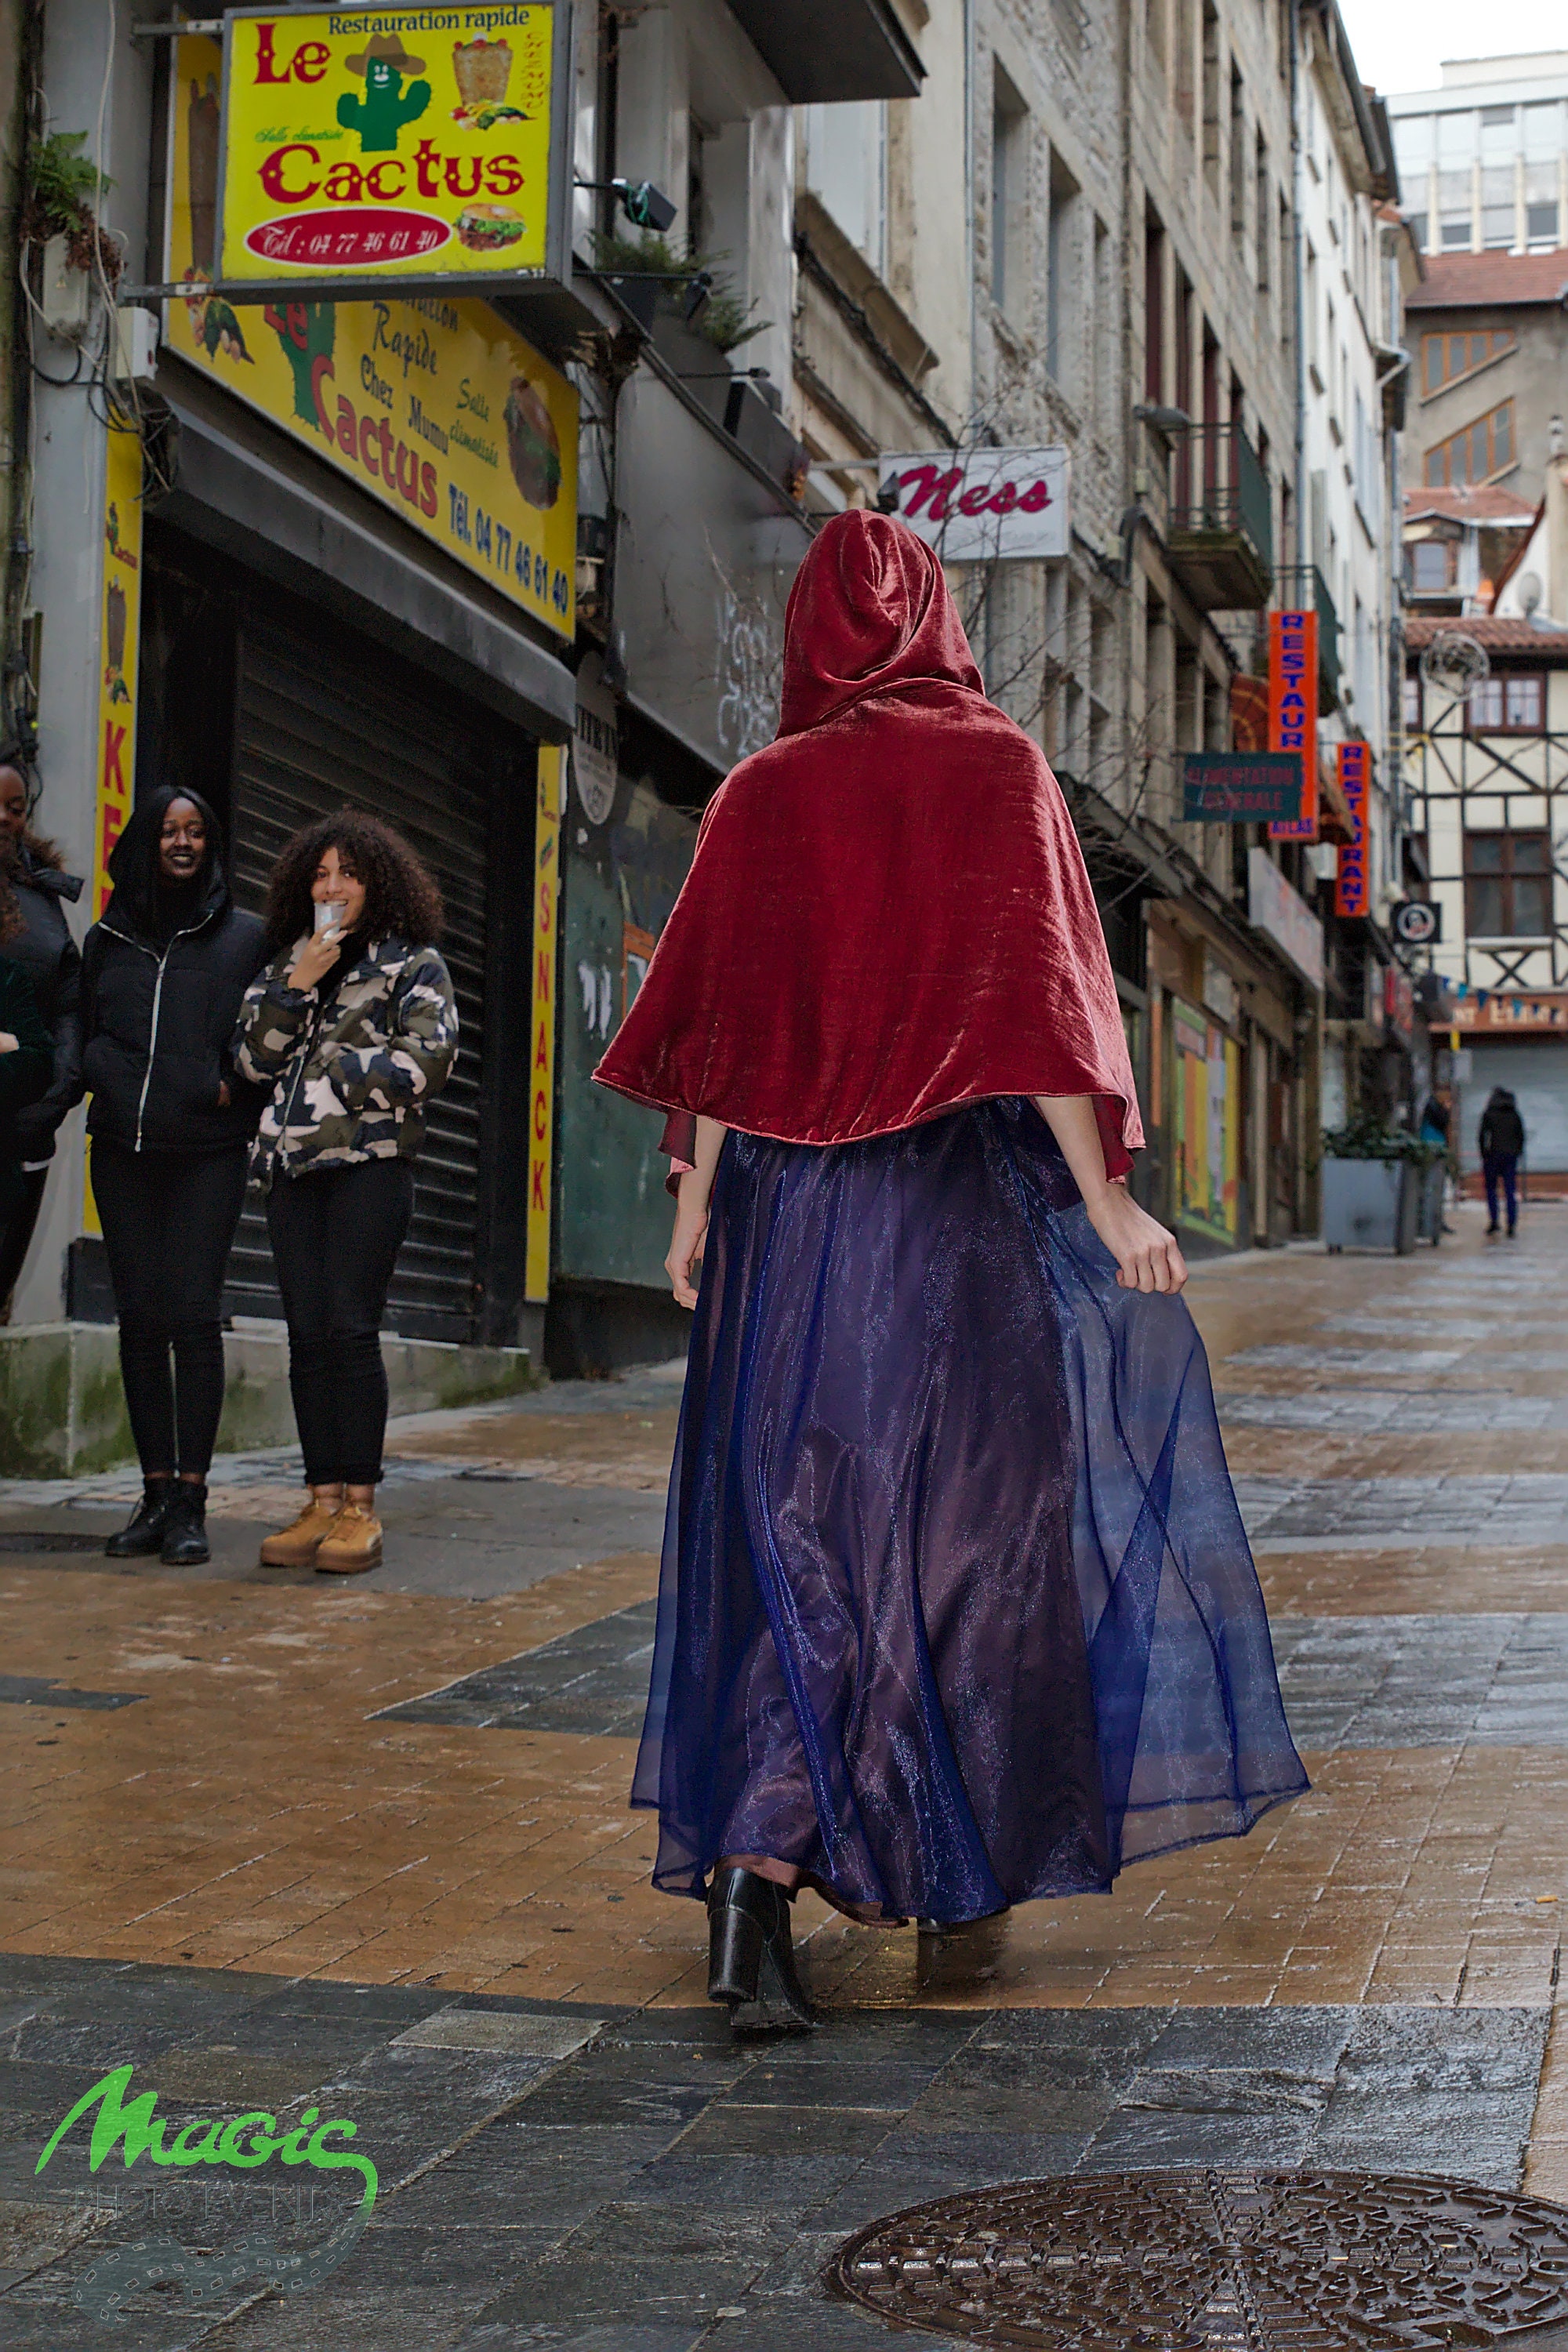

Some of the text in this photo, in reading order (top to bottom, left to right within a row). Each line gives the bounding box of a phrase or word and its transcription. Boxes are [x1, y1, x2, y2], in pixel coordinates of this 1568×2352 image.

[328, 5, 530, 35] Restauration rapide
[253, 23, 330, 85] Le
[257, 138, 524, 204] Cactus
[309, 234, 332, 255] 04
[336, 233, 358, 253] 77
[363, 231, 385, 253] 46
[390, 230, 409, 251] 61
[416, 230, 438, 250] 40
[372, 299, 437, 378] Rapide
[361, 354, 394, 409] Chez
[456, 378, 489, 422] Salle
[310, 354, 438, 519] Cactus
[898, 464, 1053, 522] Ness
[475, 507, 492, 564] 04
[496, 522, 511, 575] 77
[553, 568, 568, 618] 40
[1279, 615, 1305, 798] RESTAUR
[532, 881, 550, 1212] SNACK
